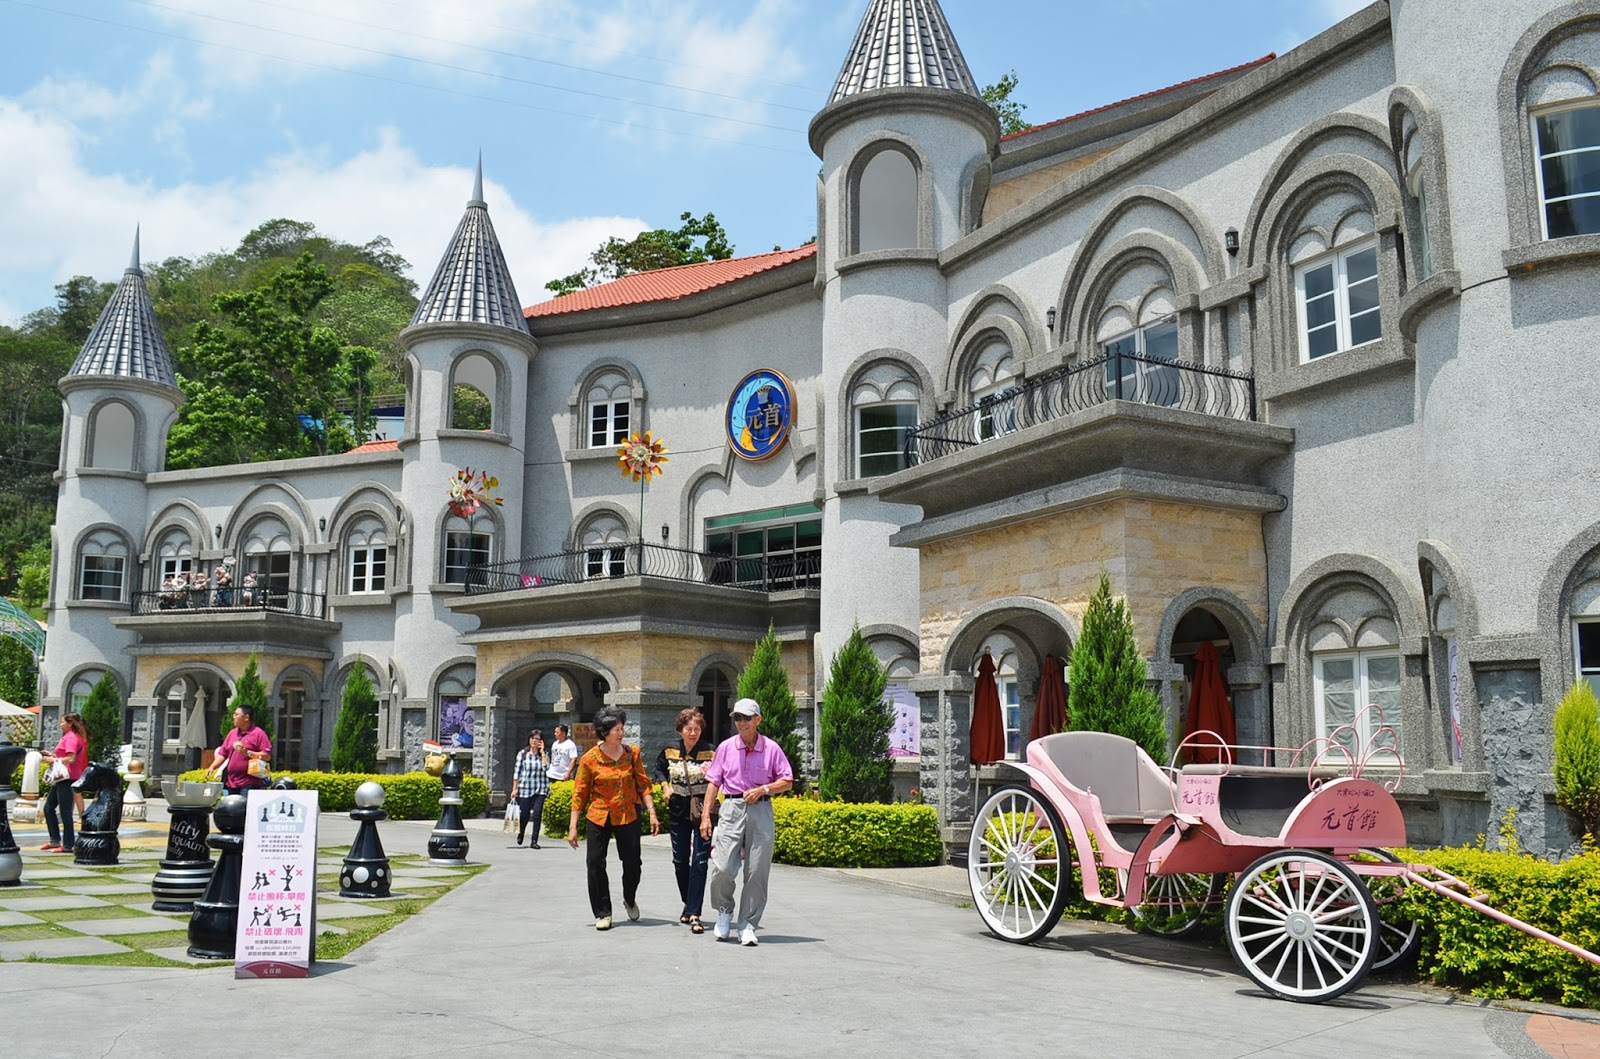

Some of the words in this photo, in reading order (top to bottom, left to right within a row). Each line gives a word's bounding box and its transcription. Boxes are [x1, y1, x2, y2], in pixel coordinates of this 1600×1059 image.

[746, 403, 782, 430] 元首
[1182, 789, 1216, 806] 元首館
[1320, 803, 1380, 832] 元首館
